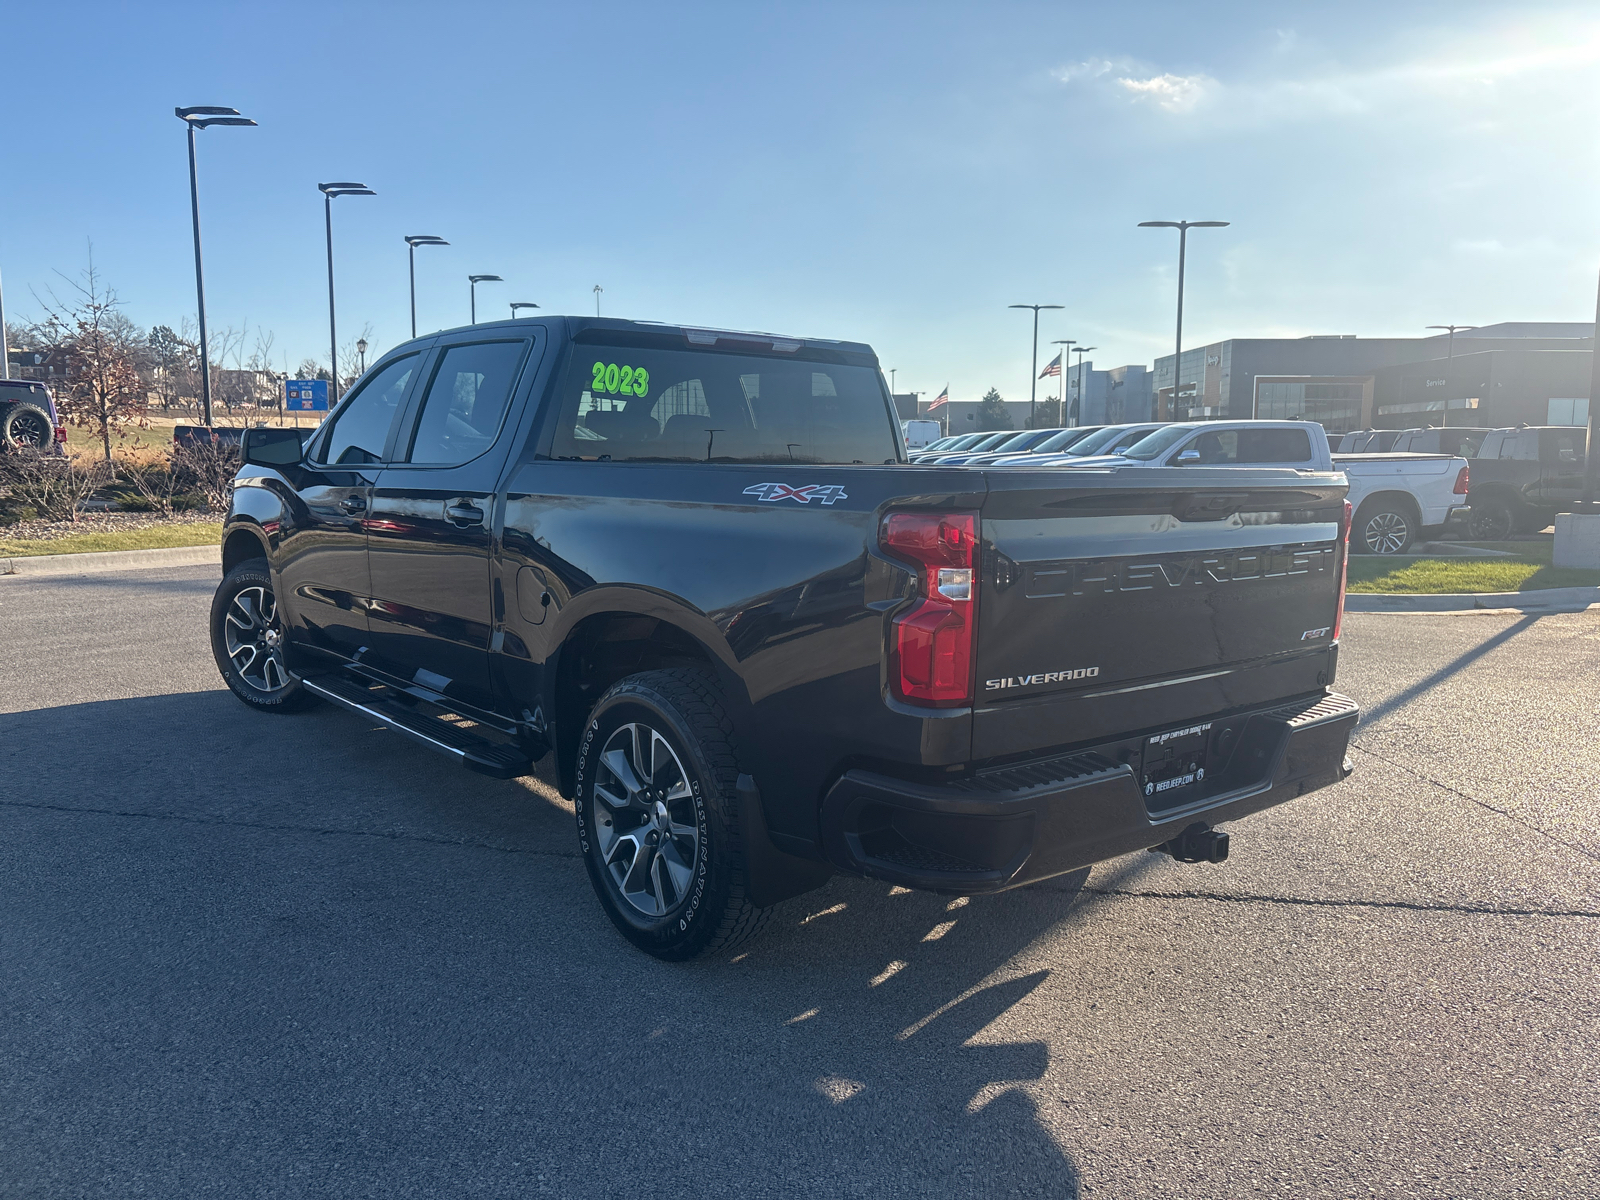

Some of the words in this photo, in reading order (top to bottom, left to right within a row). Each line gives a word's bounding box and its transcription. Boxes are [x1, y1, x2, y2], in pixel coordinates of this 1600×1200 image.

[1207, 355, 1219, 367] Jeep
[592, 361, 650, 398] 2023
[1426, 378, 1446, 388] Service
[1024, 548, 1334, 599] CHEVROLET
[1301, 627, 1331, 641] RST
[985, 666, 1100, 691] SILVERADO
[1149, 735, 1161, 744] REED
[1160, 733, 1170, 741] JEEP
[1169, 728, 1190, 739] CHRYSLER
[1189, 725, 1202, 734] DODGE
[1201, 723, 1213, 731] RAM
[1155, 774, 1195, 793] REEDJEEP.COM
[685, 780, 709, 922] DESTINATION
